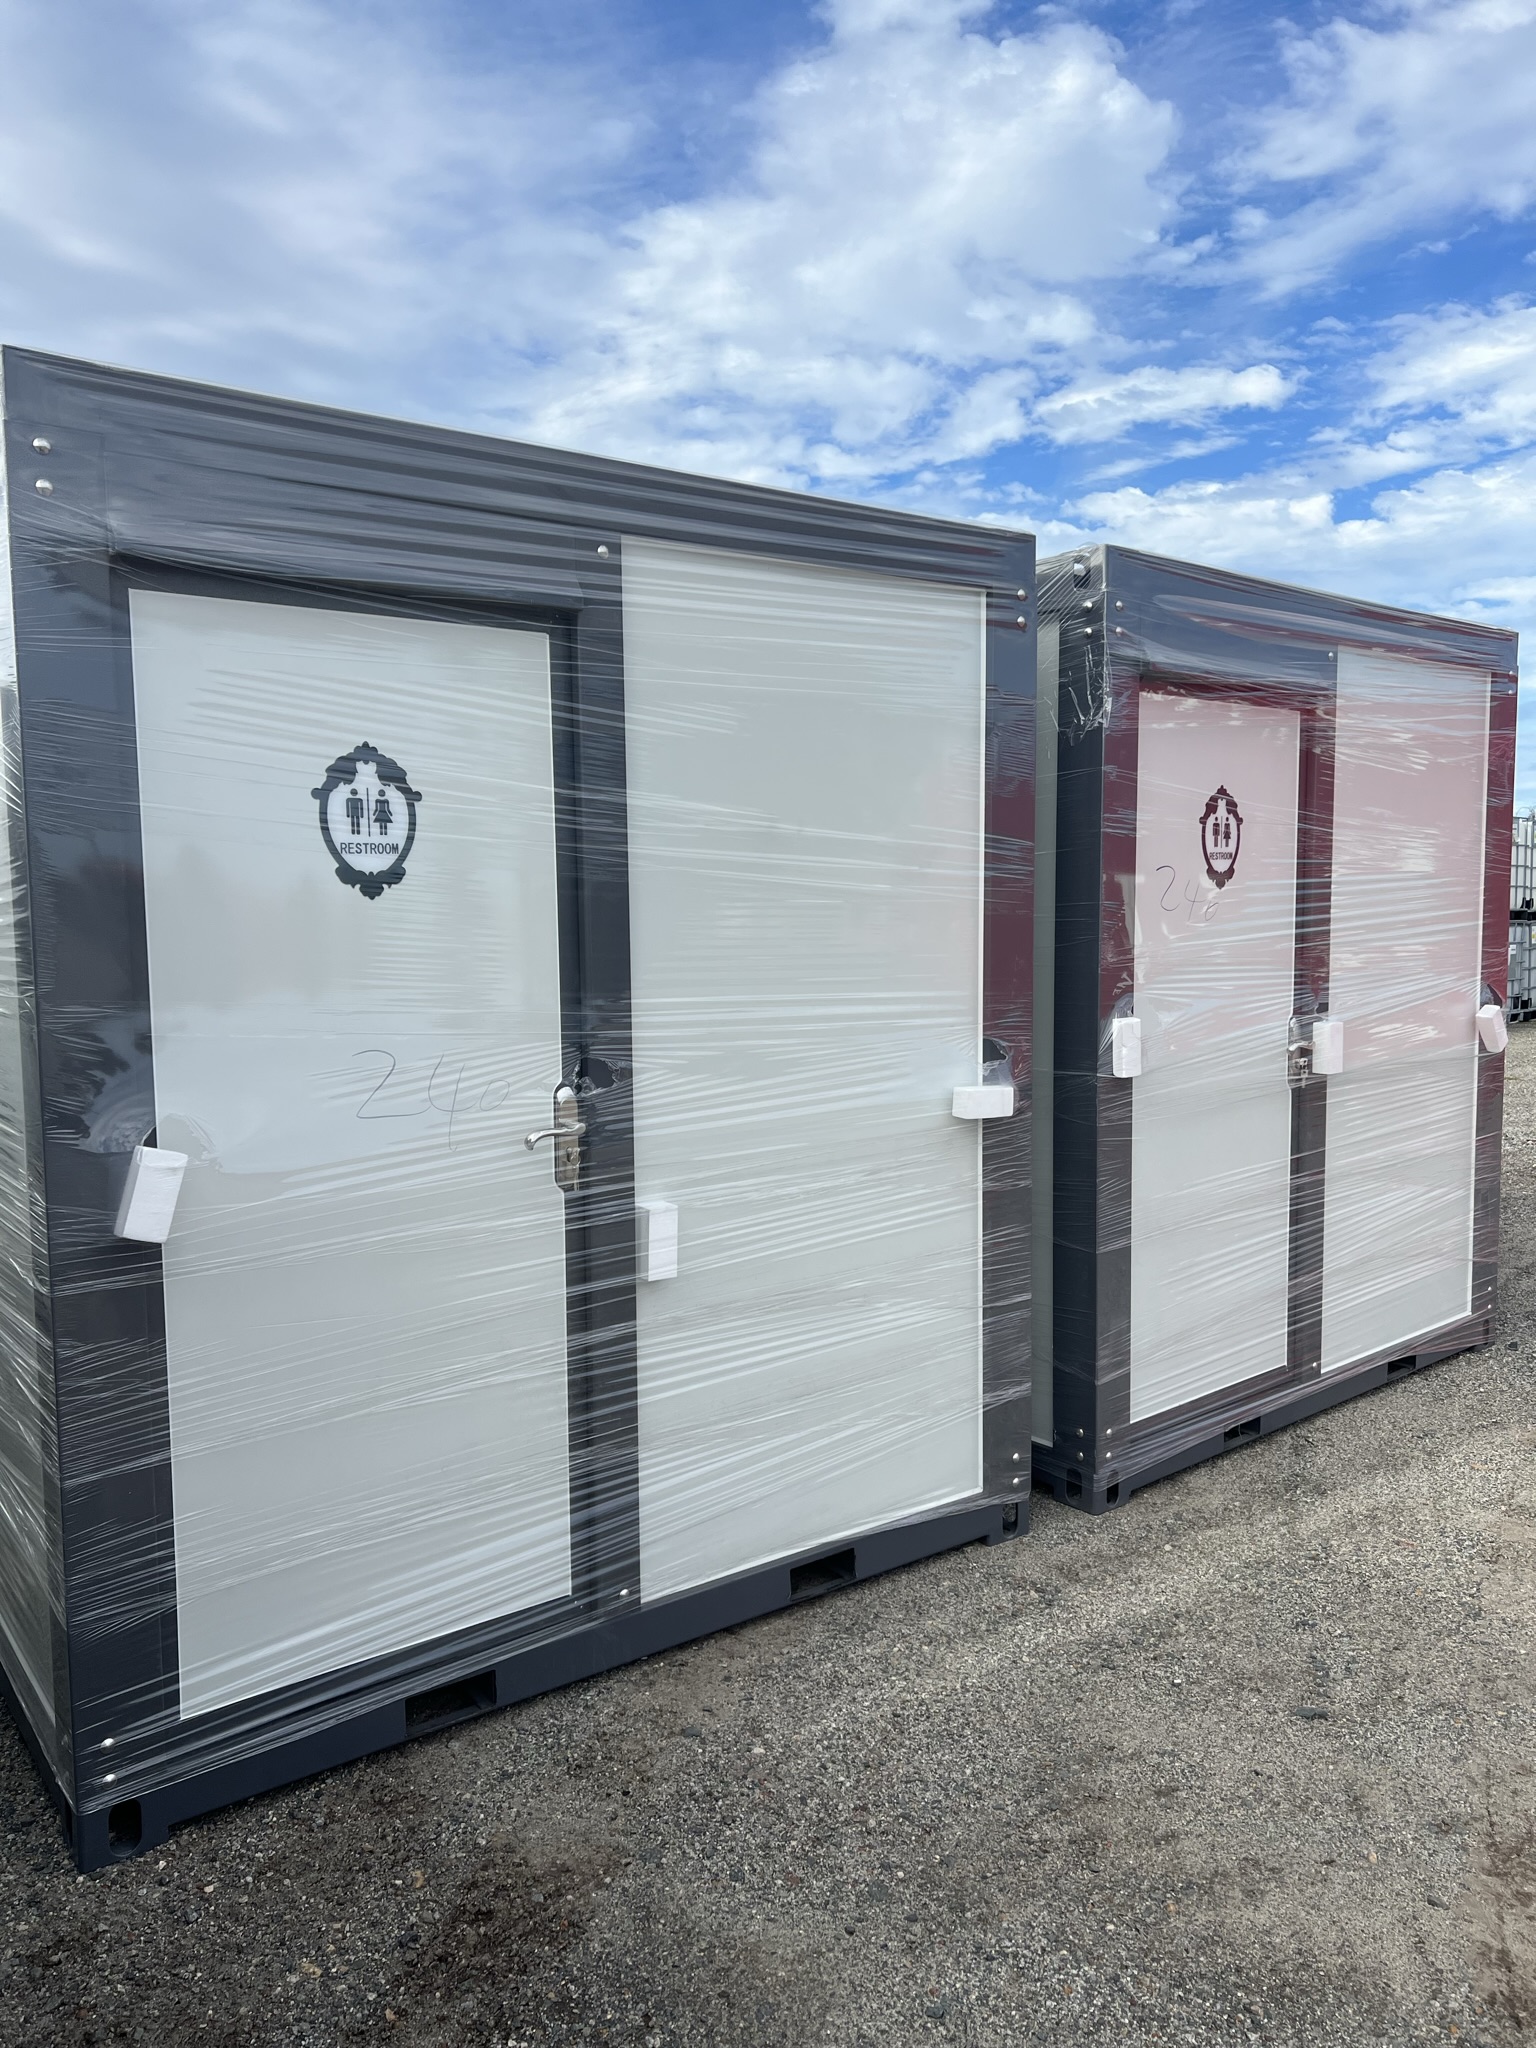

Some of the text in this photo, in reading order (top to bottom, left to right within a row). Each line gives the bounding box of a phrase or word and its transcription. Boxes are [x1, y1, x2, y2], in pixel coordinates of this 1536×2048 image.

[340, 842, 399, 855] RESTROOM
[1209, 852, 1233, 860] RESTROOM
[352, 1049, 510, 1152] 240
